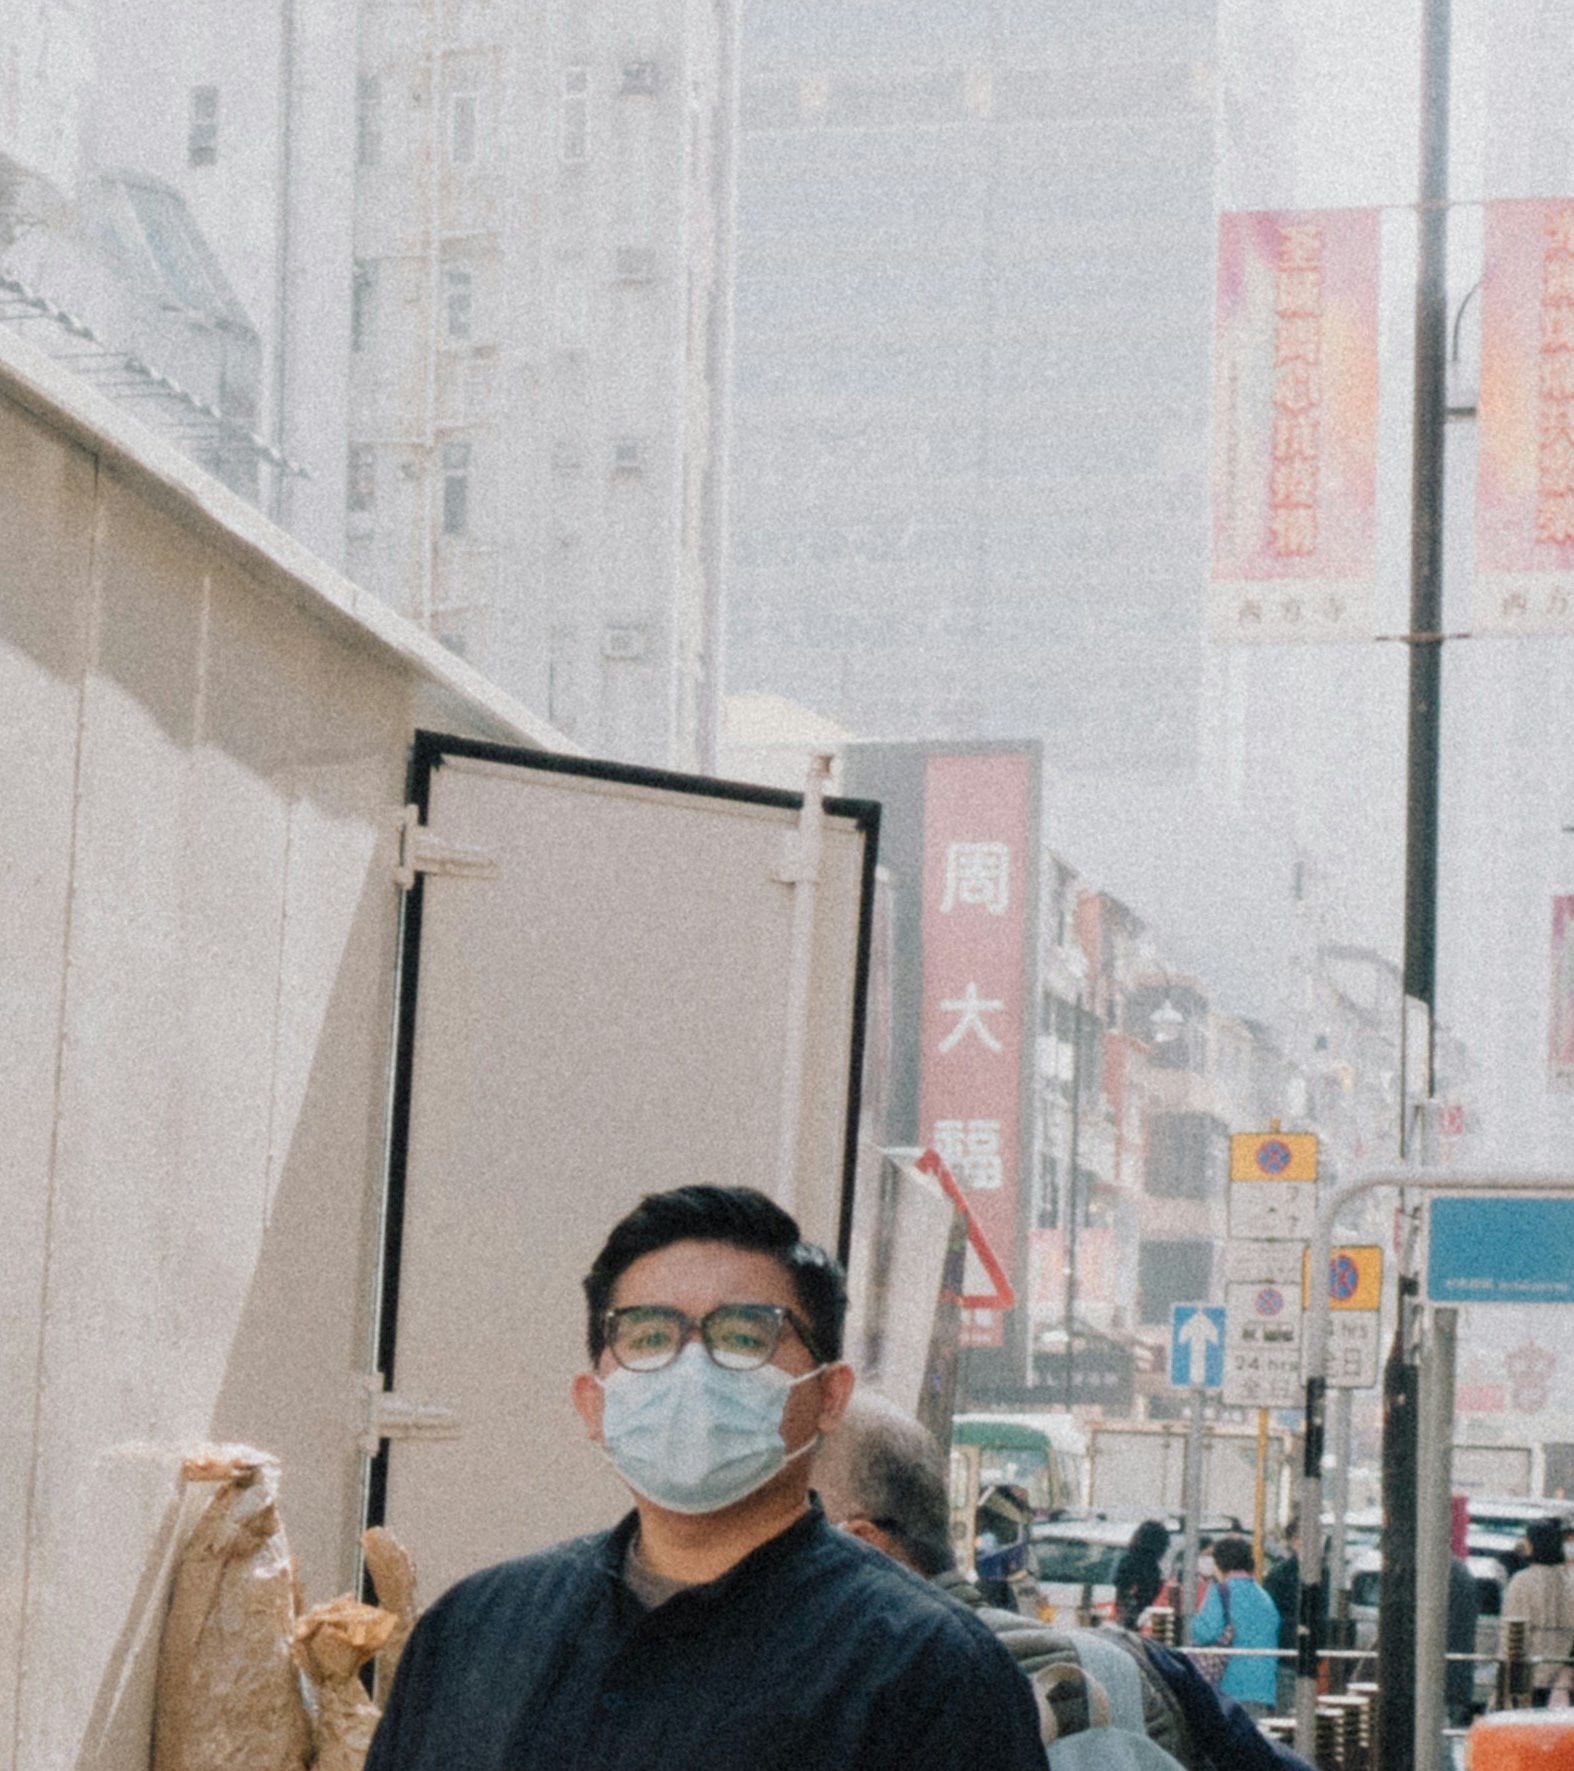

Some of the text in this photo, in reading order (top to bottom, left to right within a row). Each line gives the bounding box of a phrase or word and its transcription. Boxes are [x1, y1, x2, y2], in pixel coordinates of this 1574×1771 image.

[933, 841, 1010, 1190] 周大福
[1236, 1355, 1260, 1371] 24
